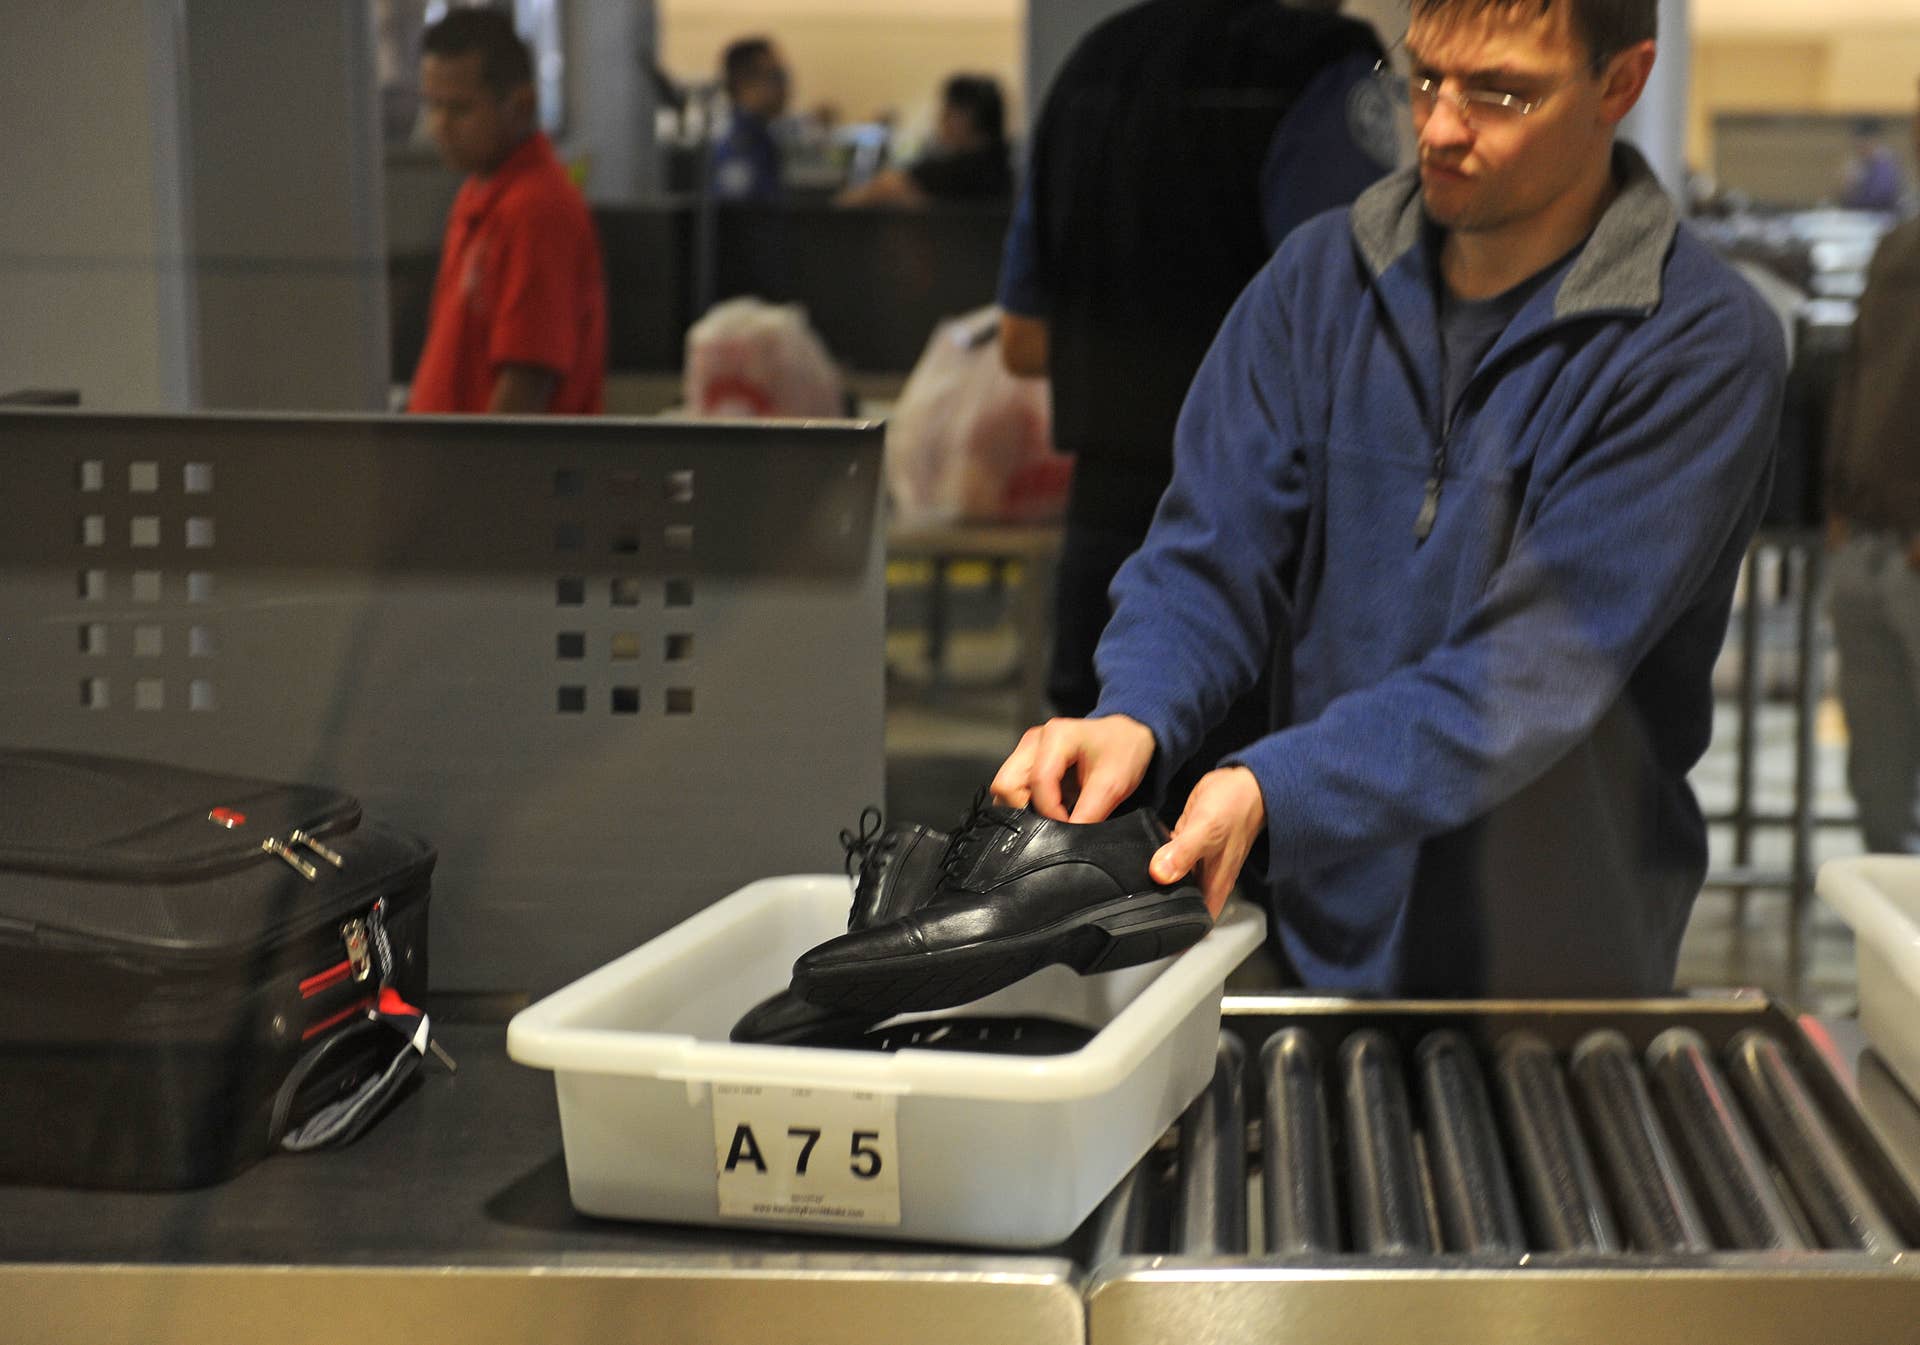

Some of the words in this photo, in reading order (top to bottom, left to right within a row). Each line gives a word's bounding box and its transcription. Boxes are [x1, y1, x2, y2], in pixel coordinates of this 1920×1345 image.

[724, 1122, 768, 1174] A
[787, 1126, 821, 1176] 7
[850, 1131, 882, 1179] 5
